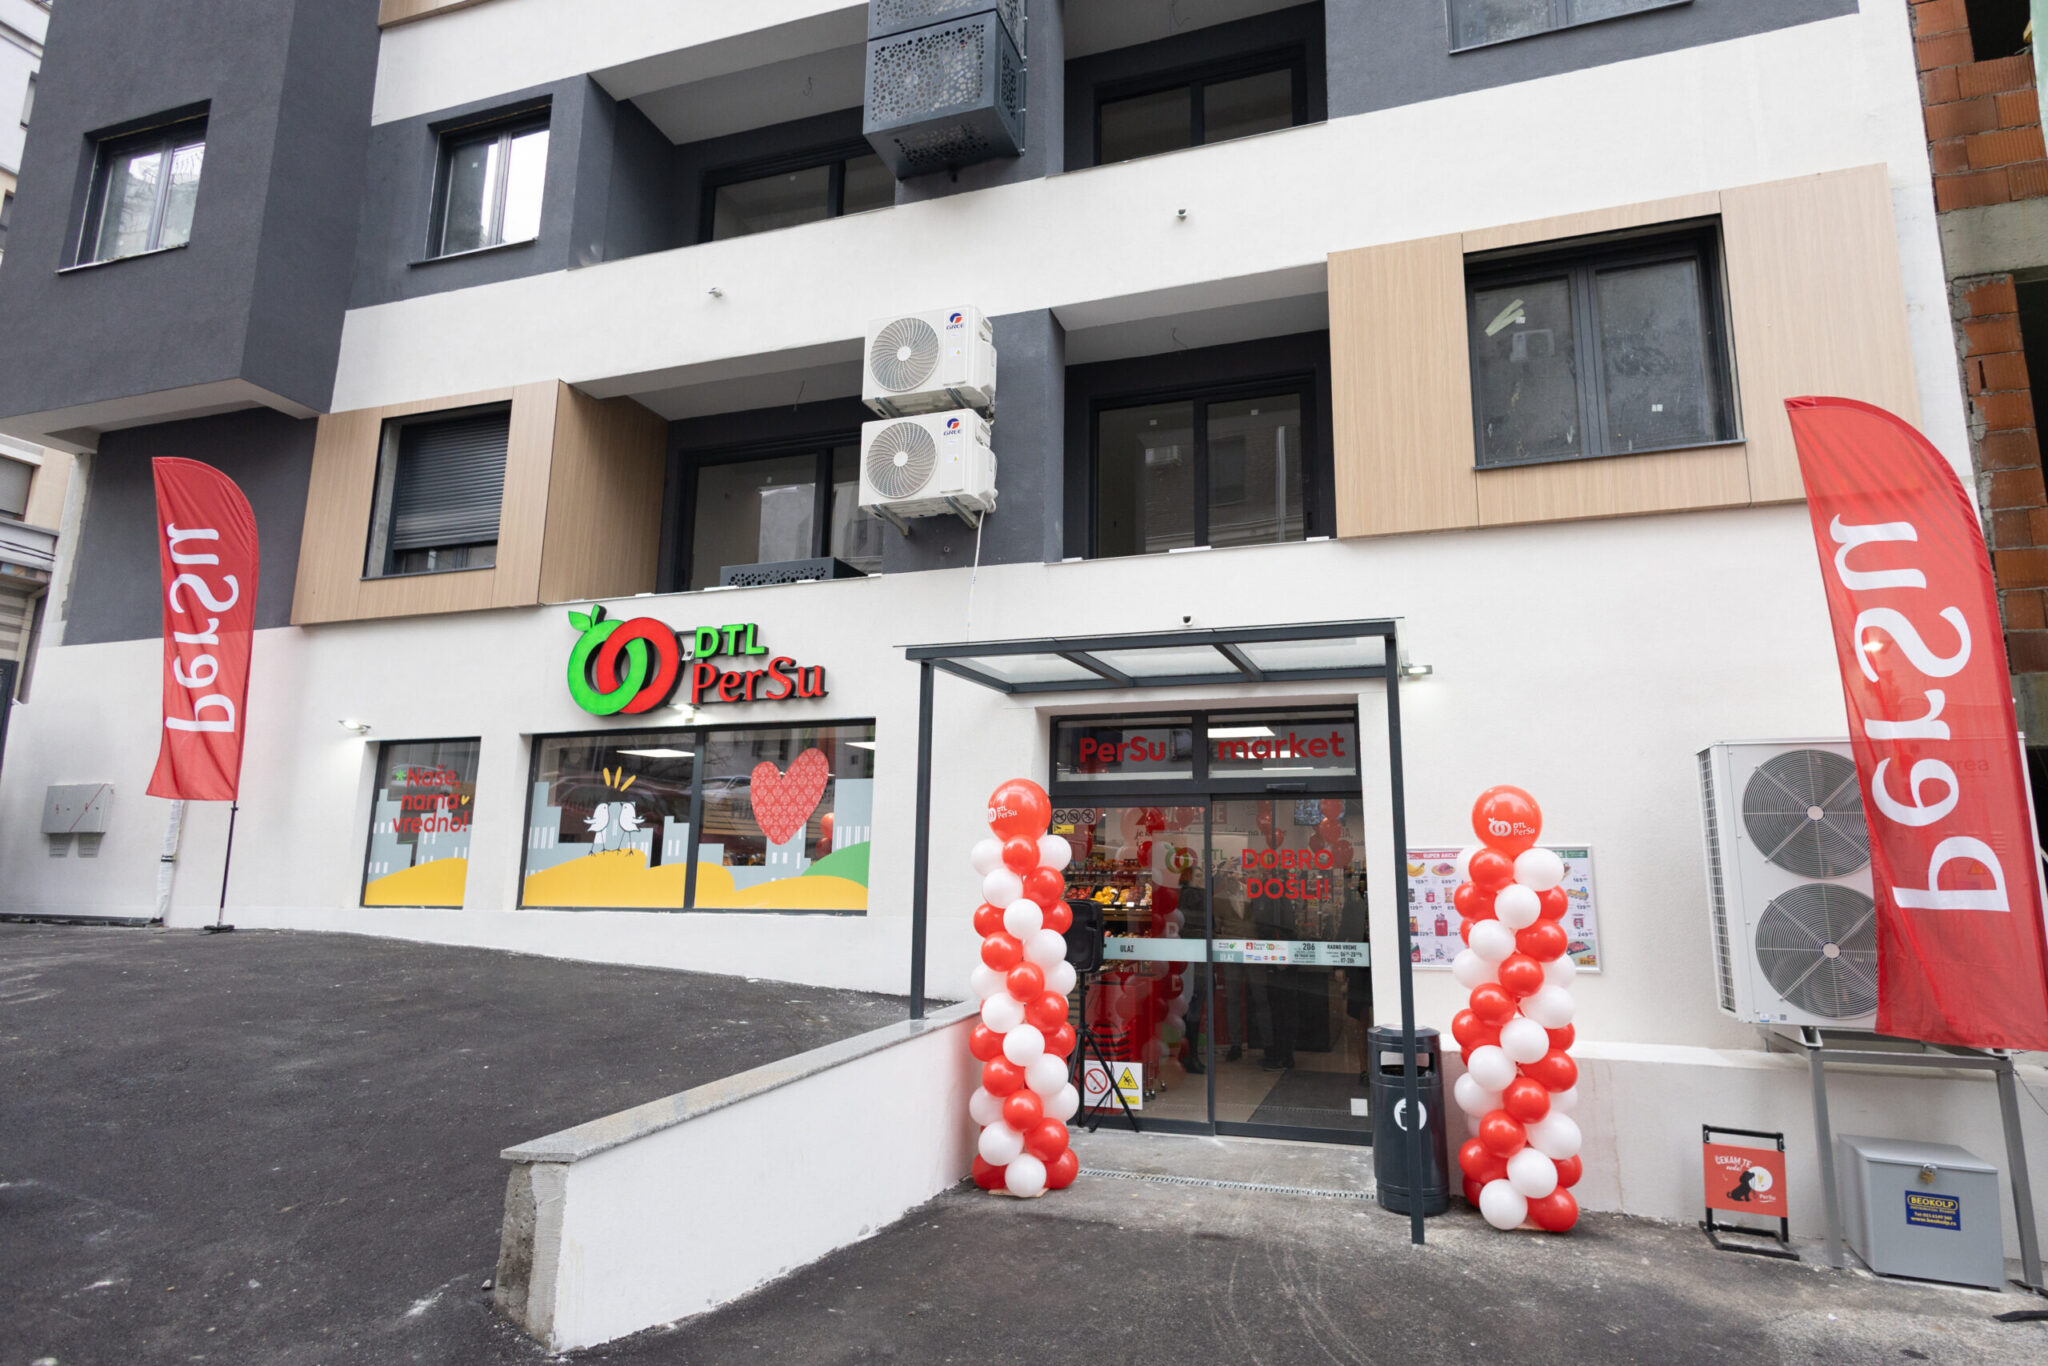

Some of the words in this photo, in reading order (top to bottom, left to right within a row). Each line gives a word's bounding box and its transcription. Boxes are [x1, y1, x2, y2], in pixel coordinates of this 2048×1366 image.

[694, 623, 767, 658] DTL
[691, 656, 826, 704] PerSu
[1079, 736, 1165, 763] PerSu
[1217, 731, 1346, 760] market
[406, 764, 461, 789] Naše,
[400, 793, 460, 811] nama
[392, 811, 469, 833] vredno!
[1513, 827, 1536, 836] PerSu
[1242, 848, 1334, 870] DOBRO
[1246, 873, 1331, 901] DOŠLI!
[1911, 1196, 1954, 1208] BEOKOLP
